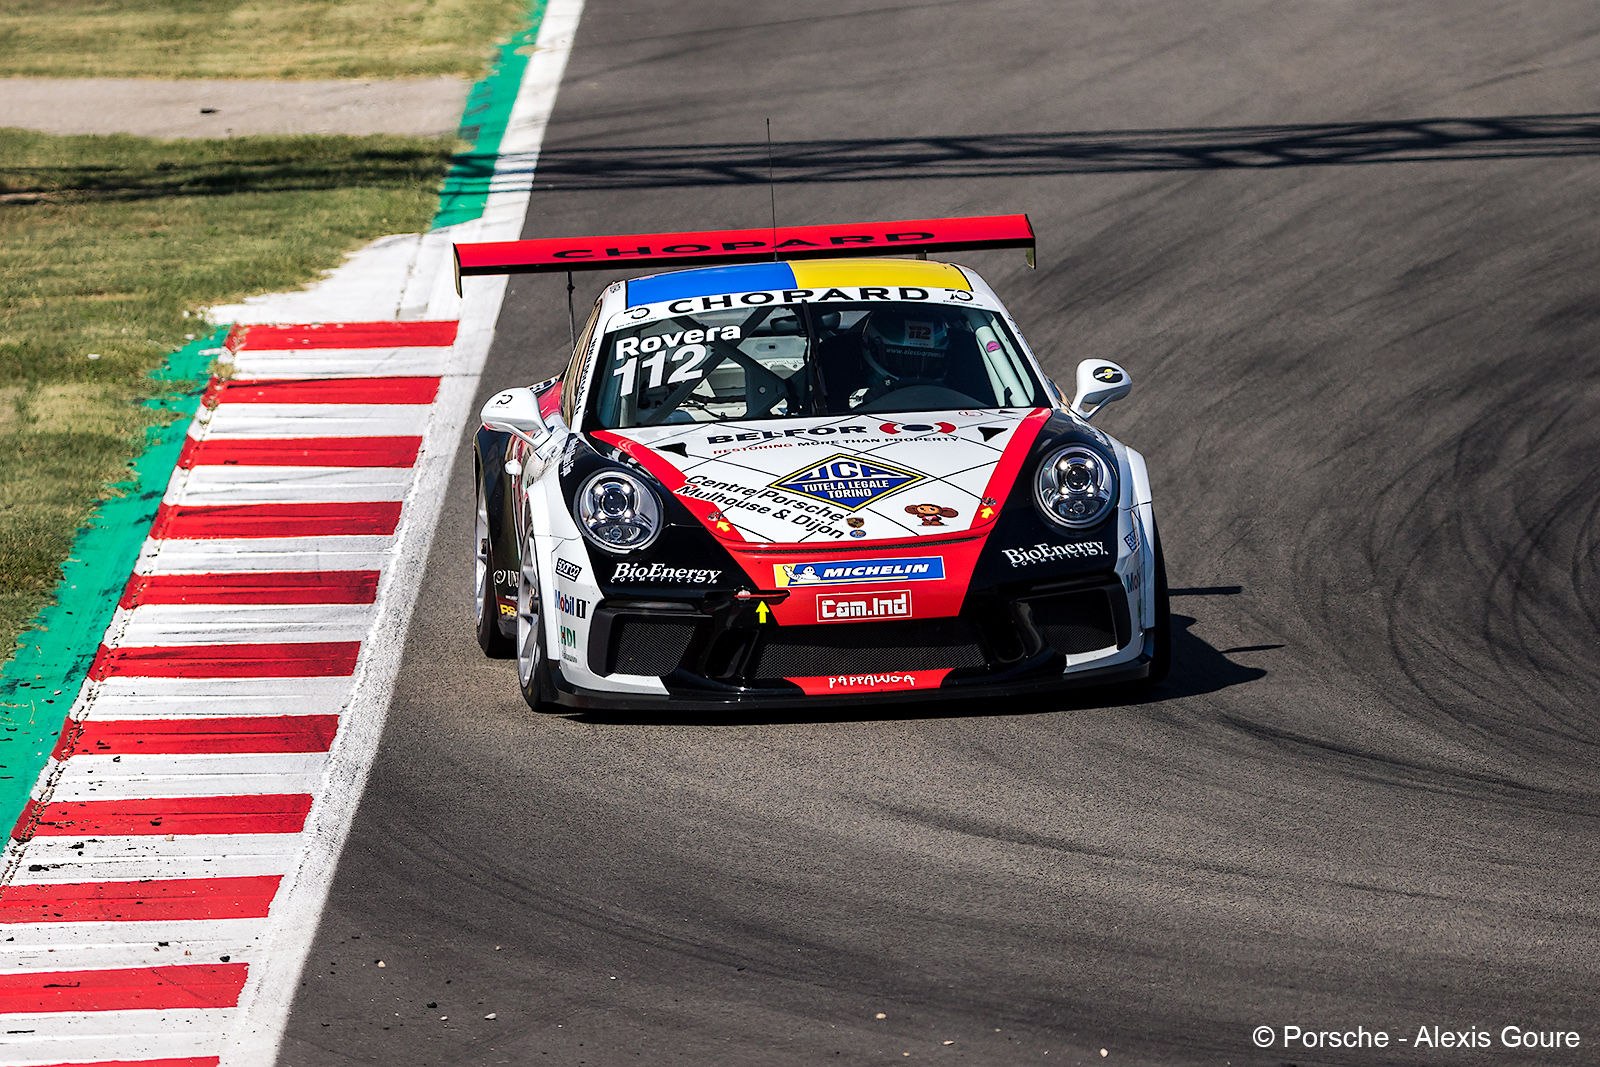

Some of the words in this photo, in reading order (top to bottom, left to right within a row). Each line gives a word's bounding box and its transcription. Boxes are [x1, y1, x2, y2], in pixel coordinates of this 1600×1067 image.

[552, 231, 935, 259] CHOPARD
[668, 286, 930, 313] CHOPARD
[615, 324, 742, 361] Rovera
[908, 325, 931, 340] 112
[613, 343, 707, 397] 112
[707, 425, 868, 445] BELFOR
[712, 442, 793, 454] RESTORING
[797, 438, 840, 447] MORE
[884, 435, 959, 443] PROPERTY
[686, 474, 757, 497] Centre
[758, 490, 844, 522] Porsche
[802, 481, 846, 493] TUTELA
[849, 479, 890, 489] LEGALE
[826, 488, 873, 499] TORINO
[676, 485, 771, 514] Mulhouse
[772, 509, 792, 521] &
[791, 513, 845, 540] Dijon
[1001, 541, 1103, 564] BioEnergy
[611, 562, 722, 584] BioEnergy
[823, 563, 930, 578] MICHELIN
[554, 589, 575, 616] Mobil
[821, 593, 907, 618] Cam.Ind
[560, 625, 576, 649] HDI
